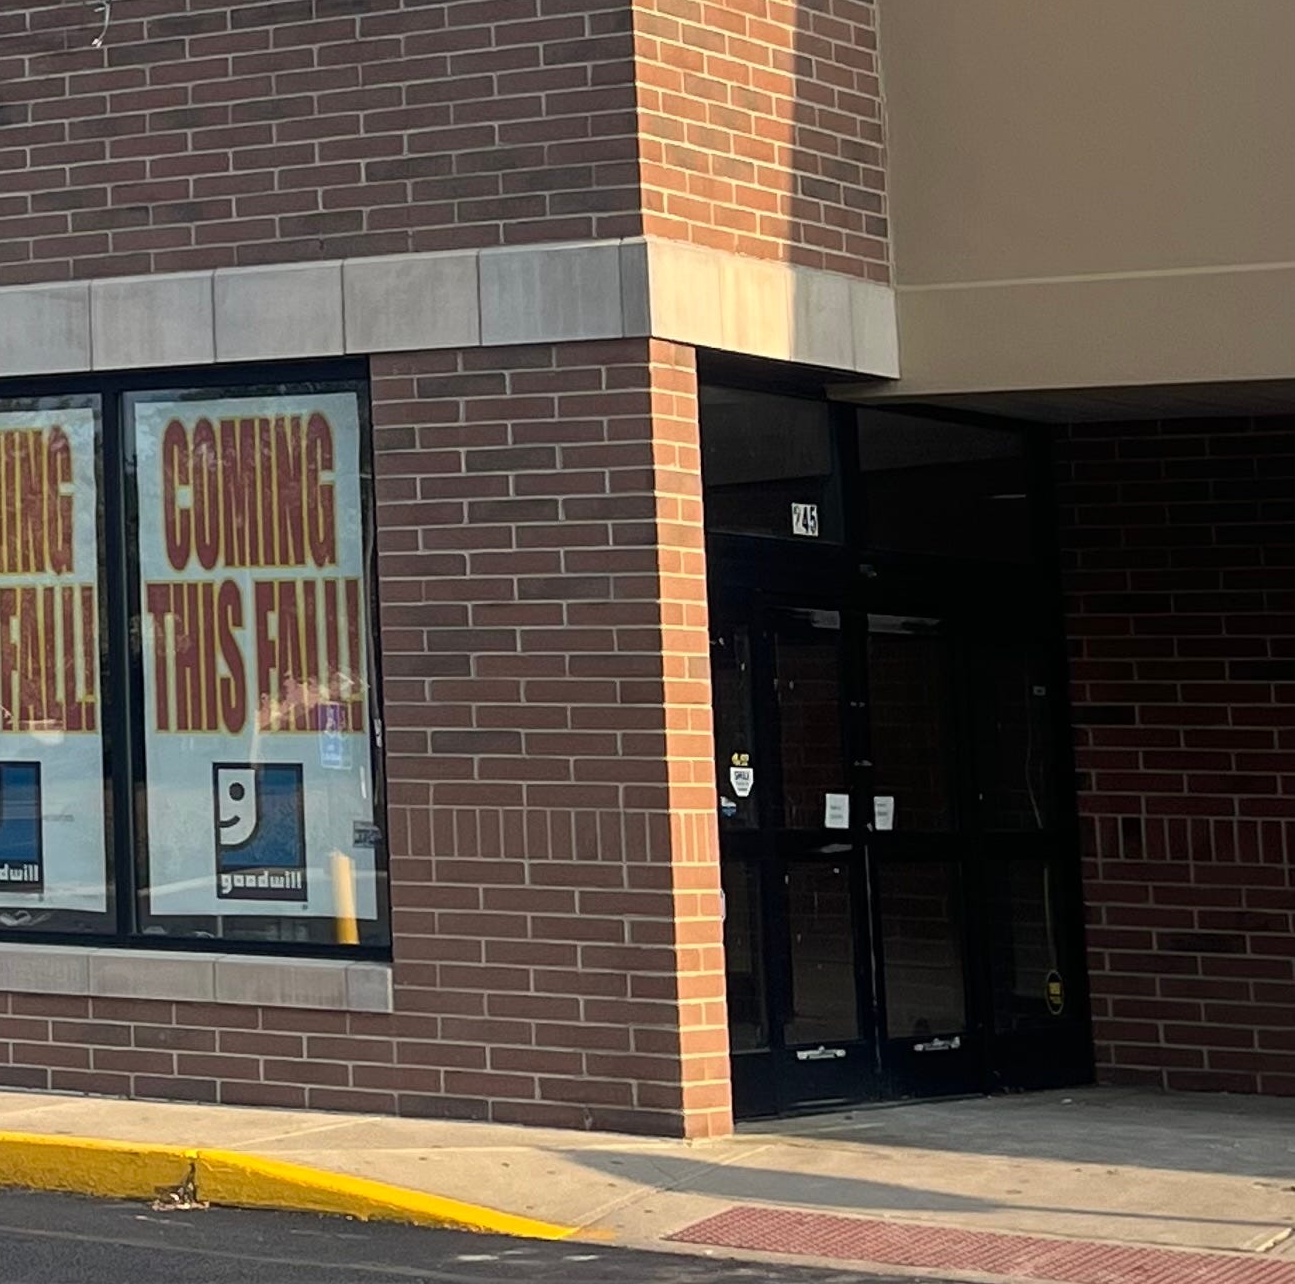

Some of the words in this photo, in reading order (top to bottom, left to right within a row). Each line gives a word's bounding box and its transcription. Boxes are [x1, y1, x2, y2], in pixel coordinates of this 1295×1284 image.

[160, 412, 337, 572] COMING
[144, 577, 249, 735] THIS
[253, 576, 366, 735] FALL
[220, 870, 304, 895] goodwill
